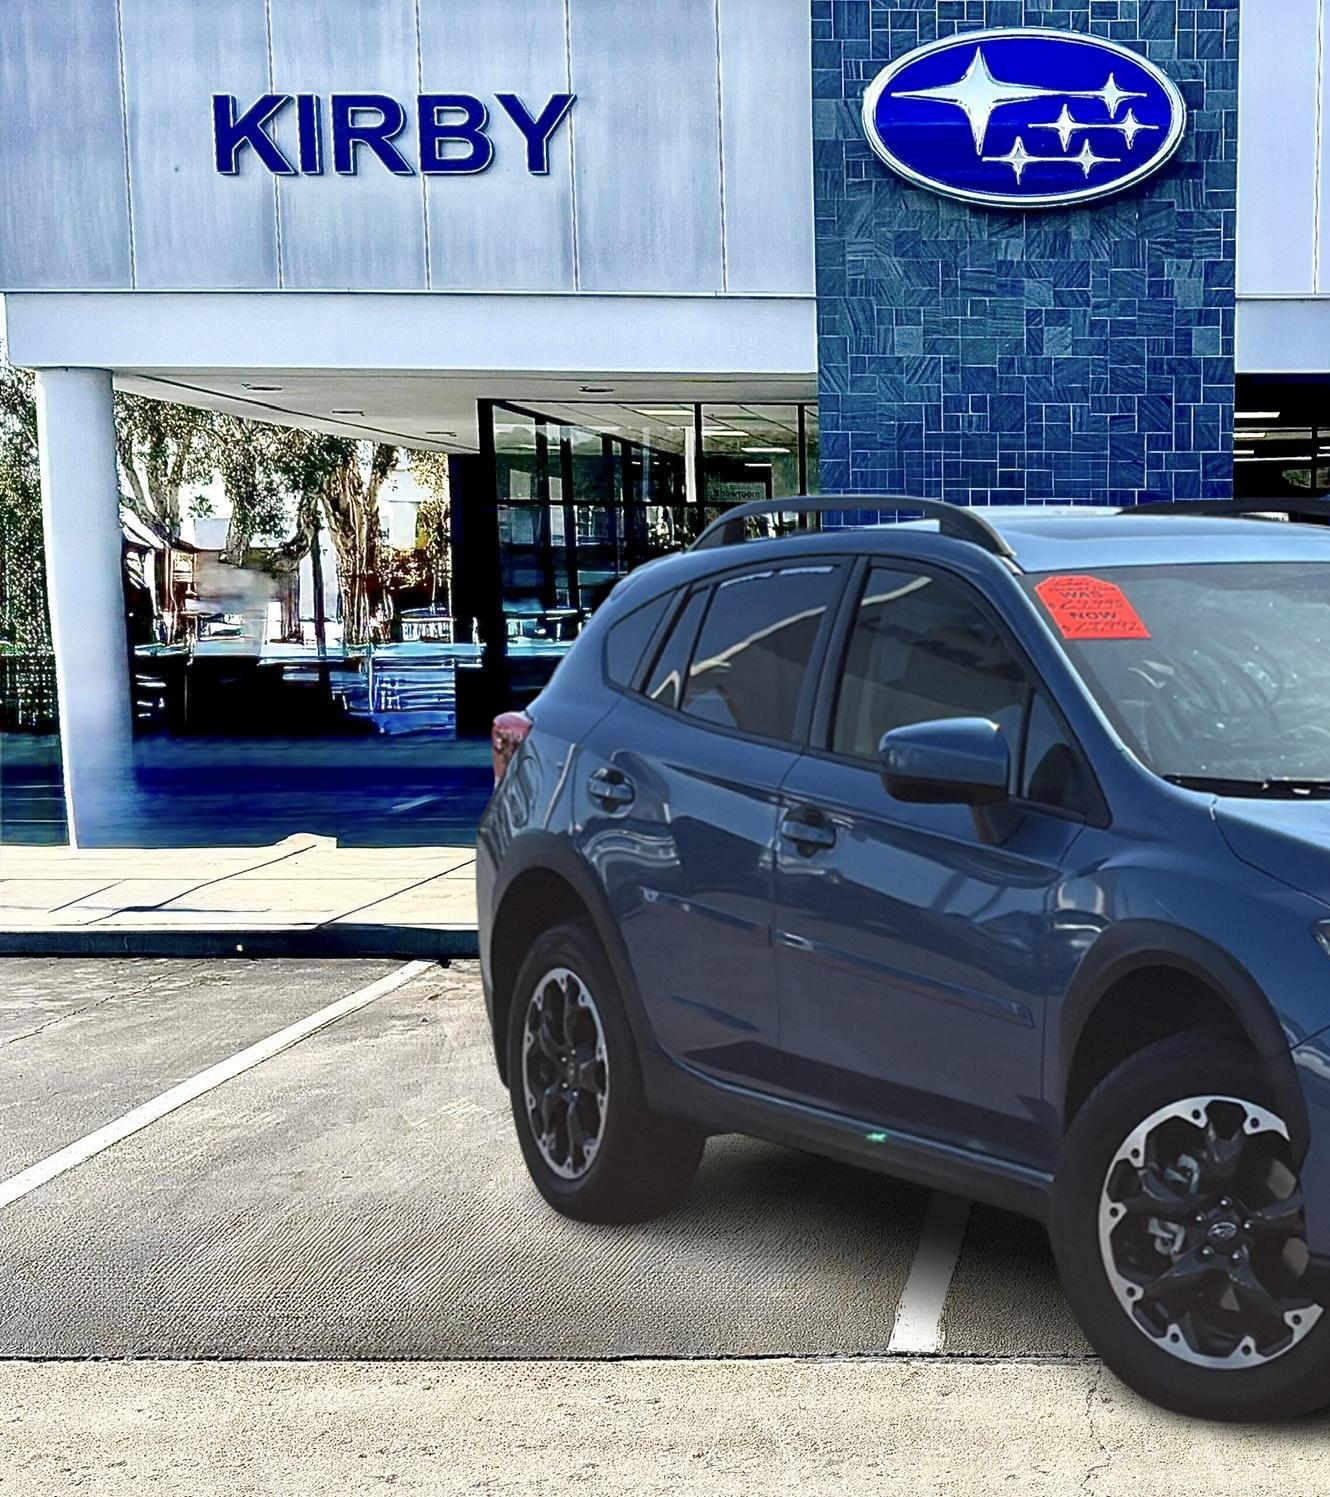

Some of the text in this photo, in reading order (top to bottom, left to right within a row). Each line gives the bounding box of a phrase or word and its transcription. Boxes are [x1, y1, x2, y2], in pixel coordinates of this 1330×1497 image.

[211, 93, 578, 176] KIRBY
[1059, 590, 1104, 598] WAS
[1070, 611, 1117, 620] NOW
